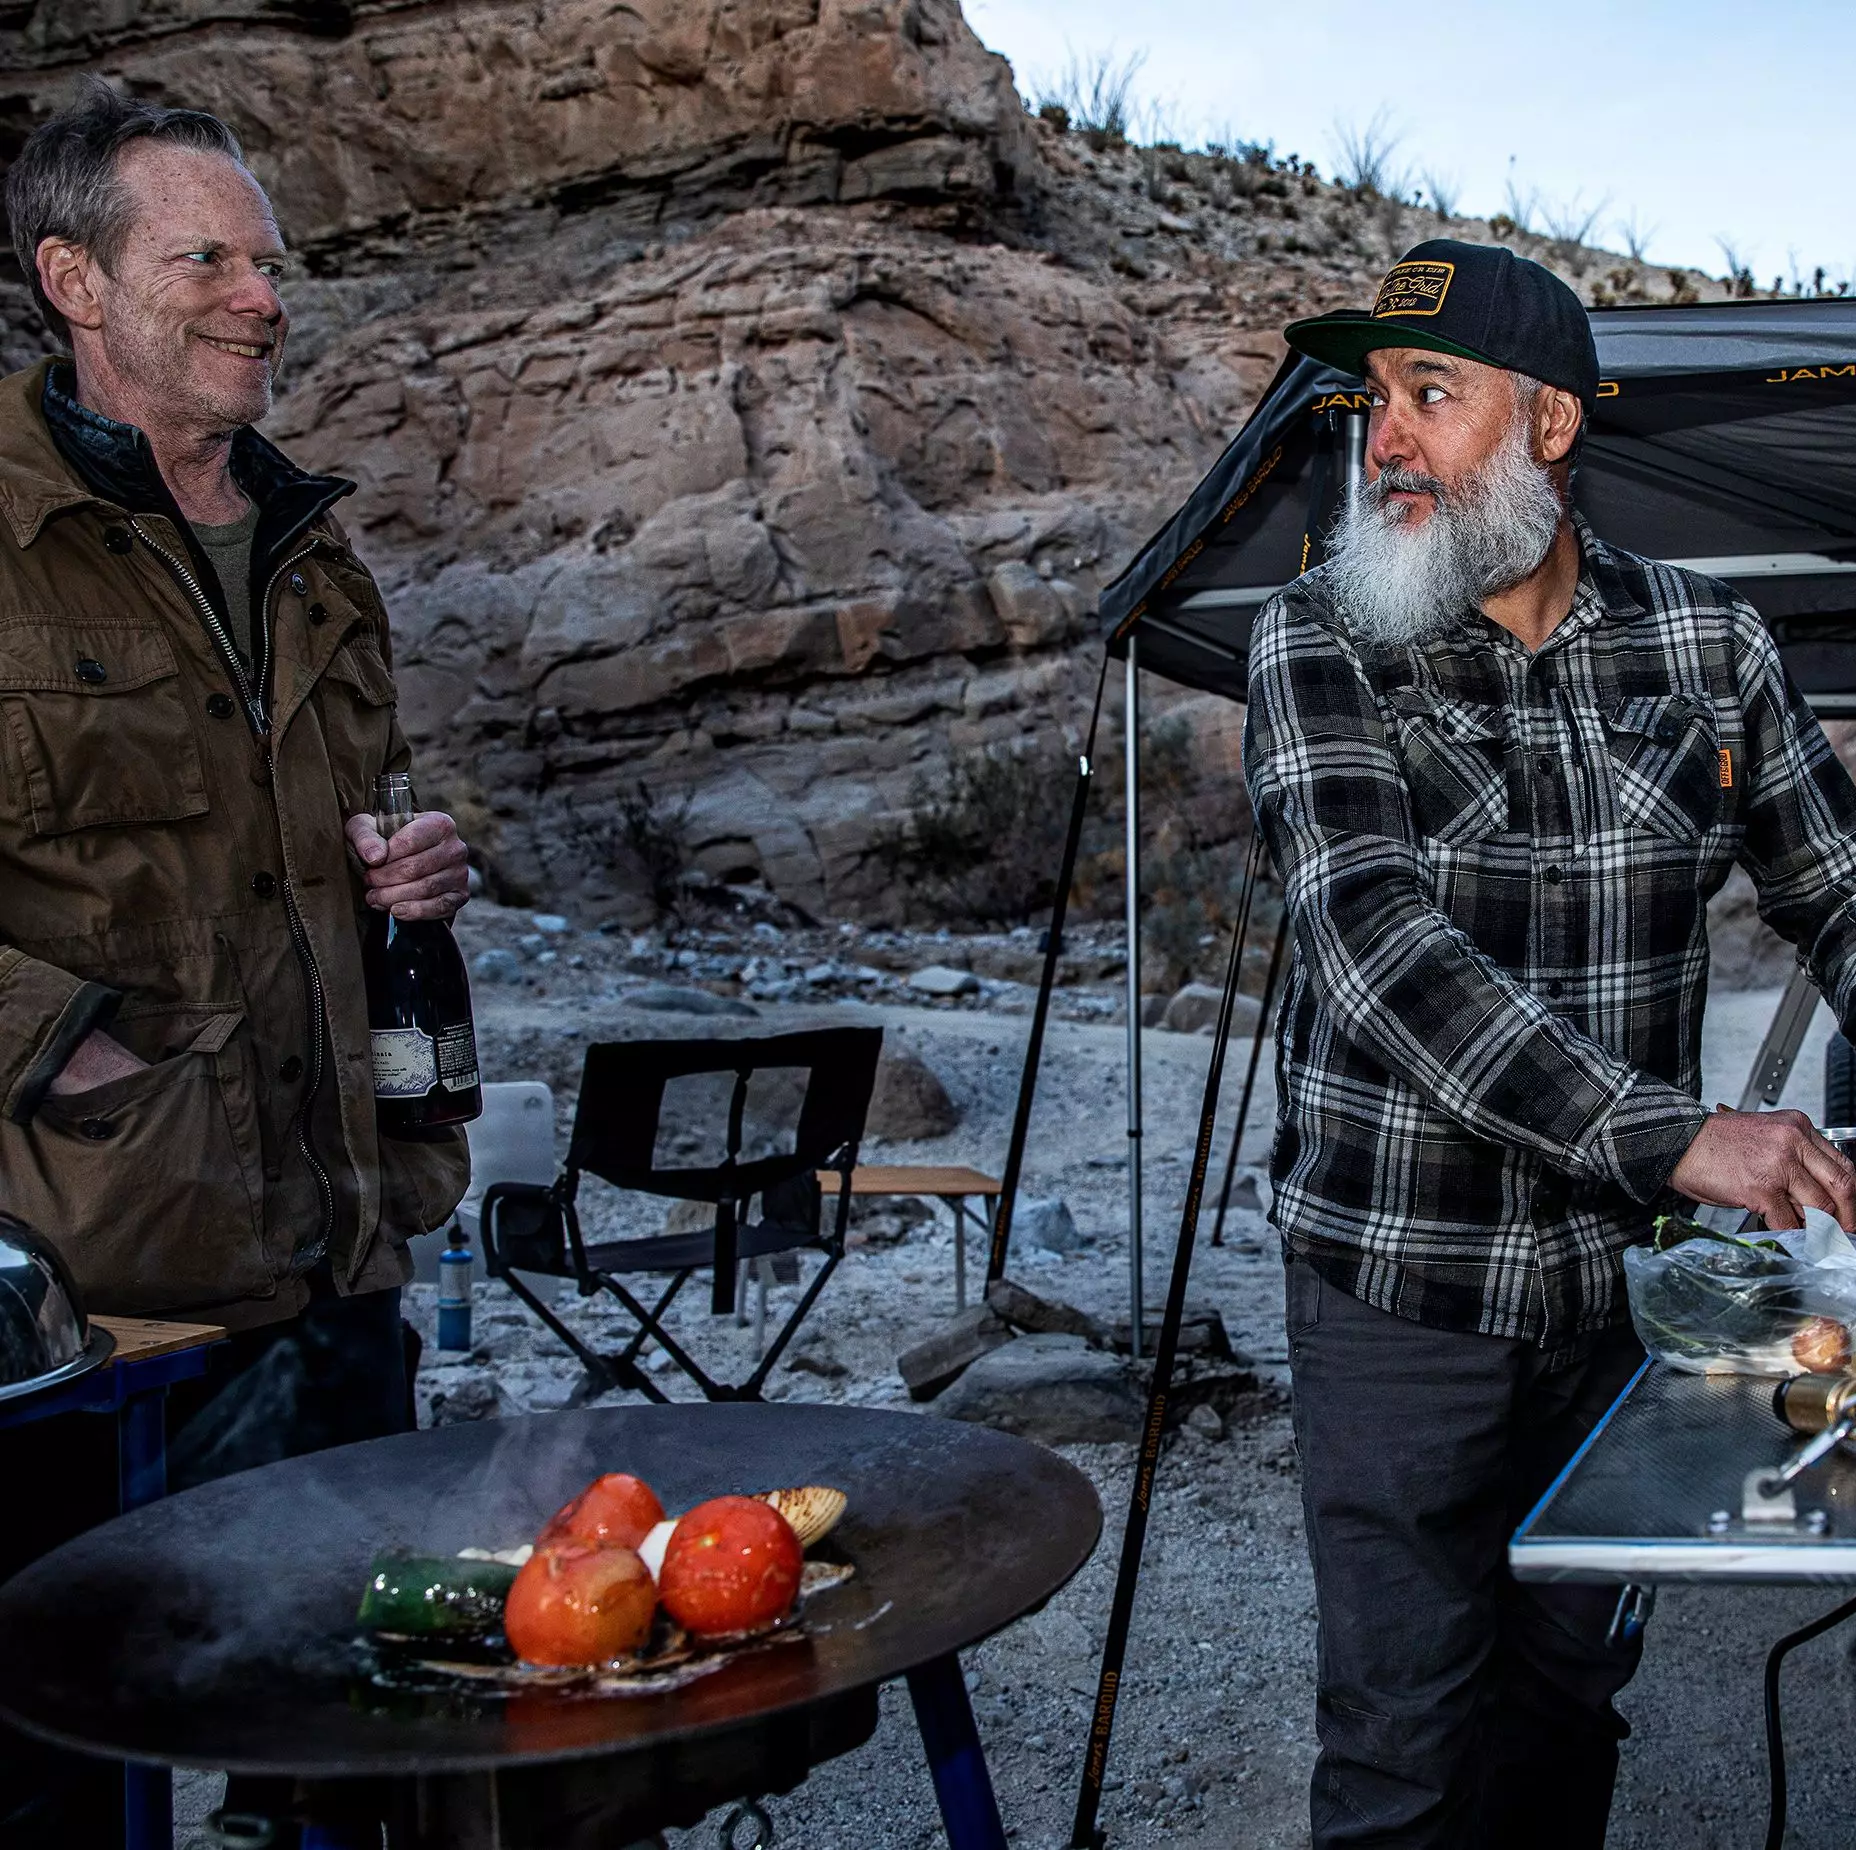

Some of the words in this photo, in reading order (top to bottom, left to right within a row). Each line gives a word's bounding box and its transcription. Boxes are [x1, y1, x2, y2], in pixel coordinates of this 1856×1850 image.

[1408, 276, 1444, 295] Grid
[1312, 394, 1371, 411] JAM
[1138, 1466, 1151, 1511] James
[1145, 1395, 1166, 1458] BAROUD
[1095, 1671, 1118, 1735] BAROUD
[1088, 1742, 1103, 1788] James
